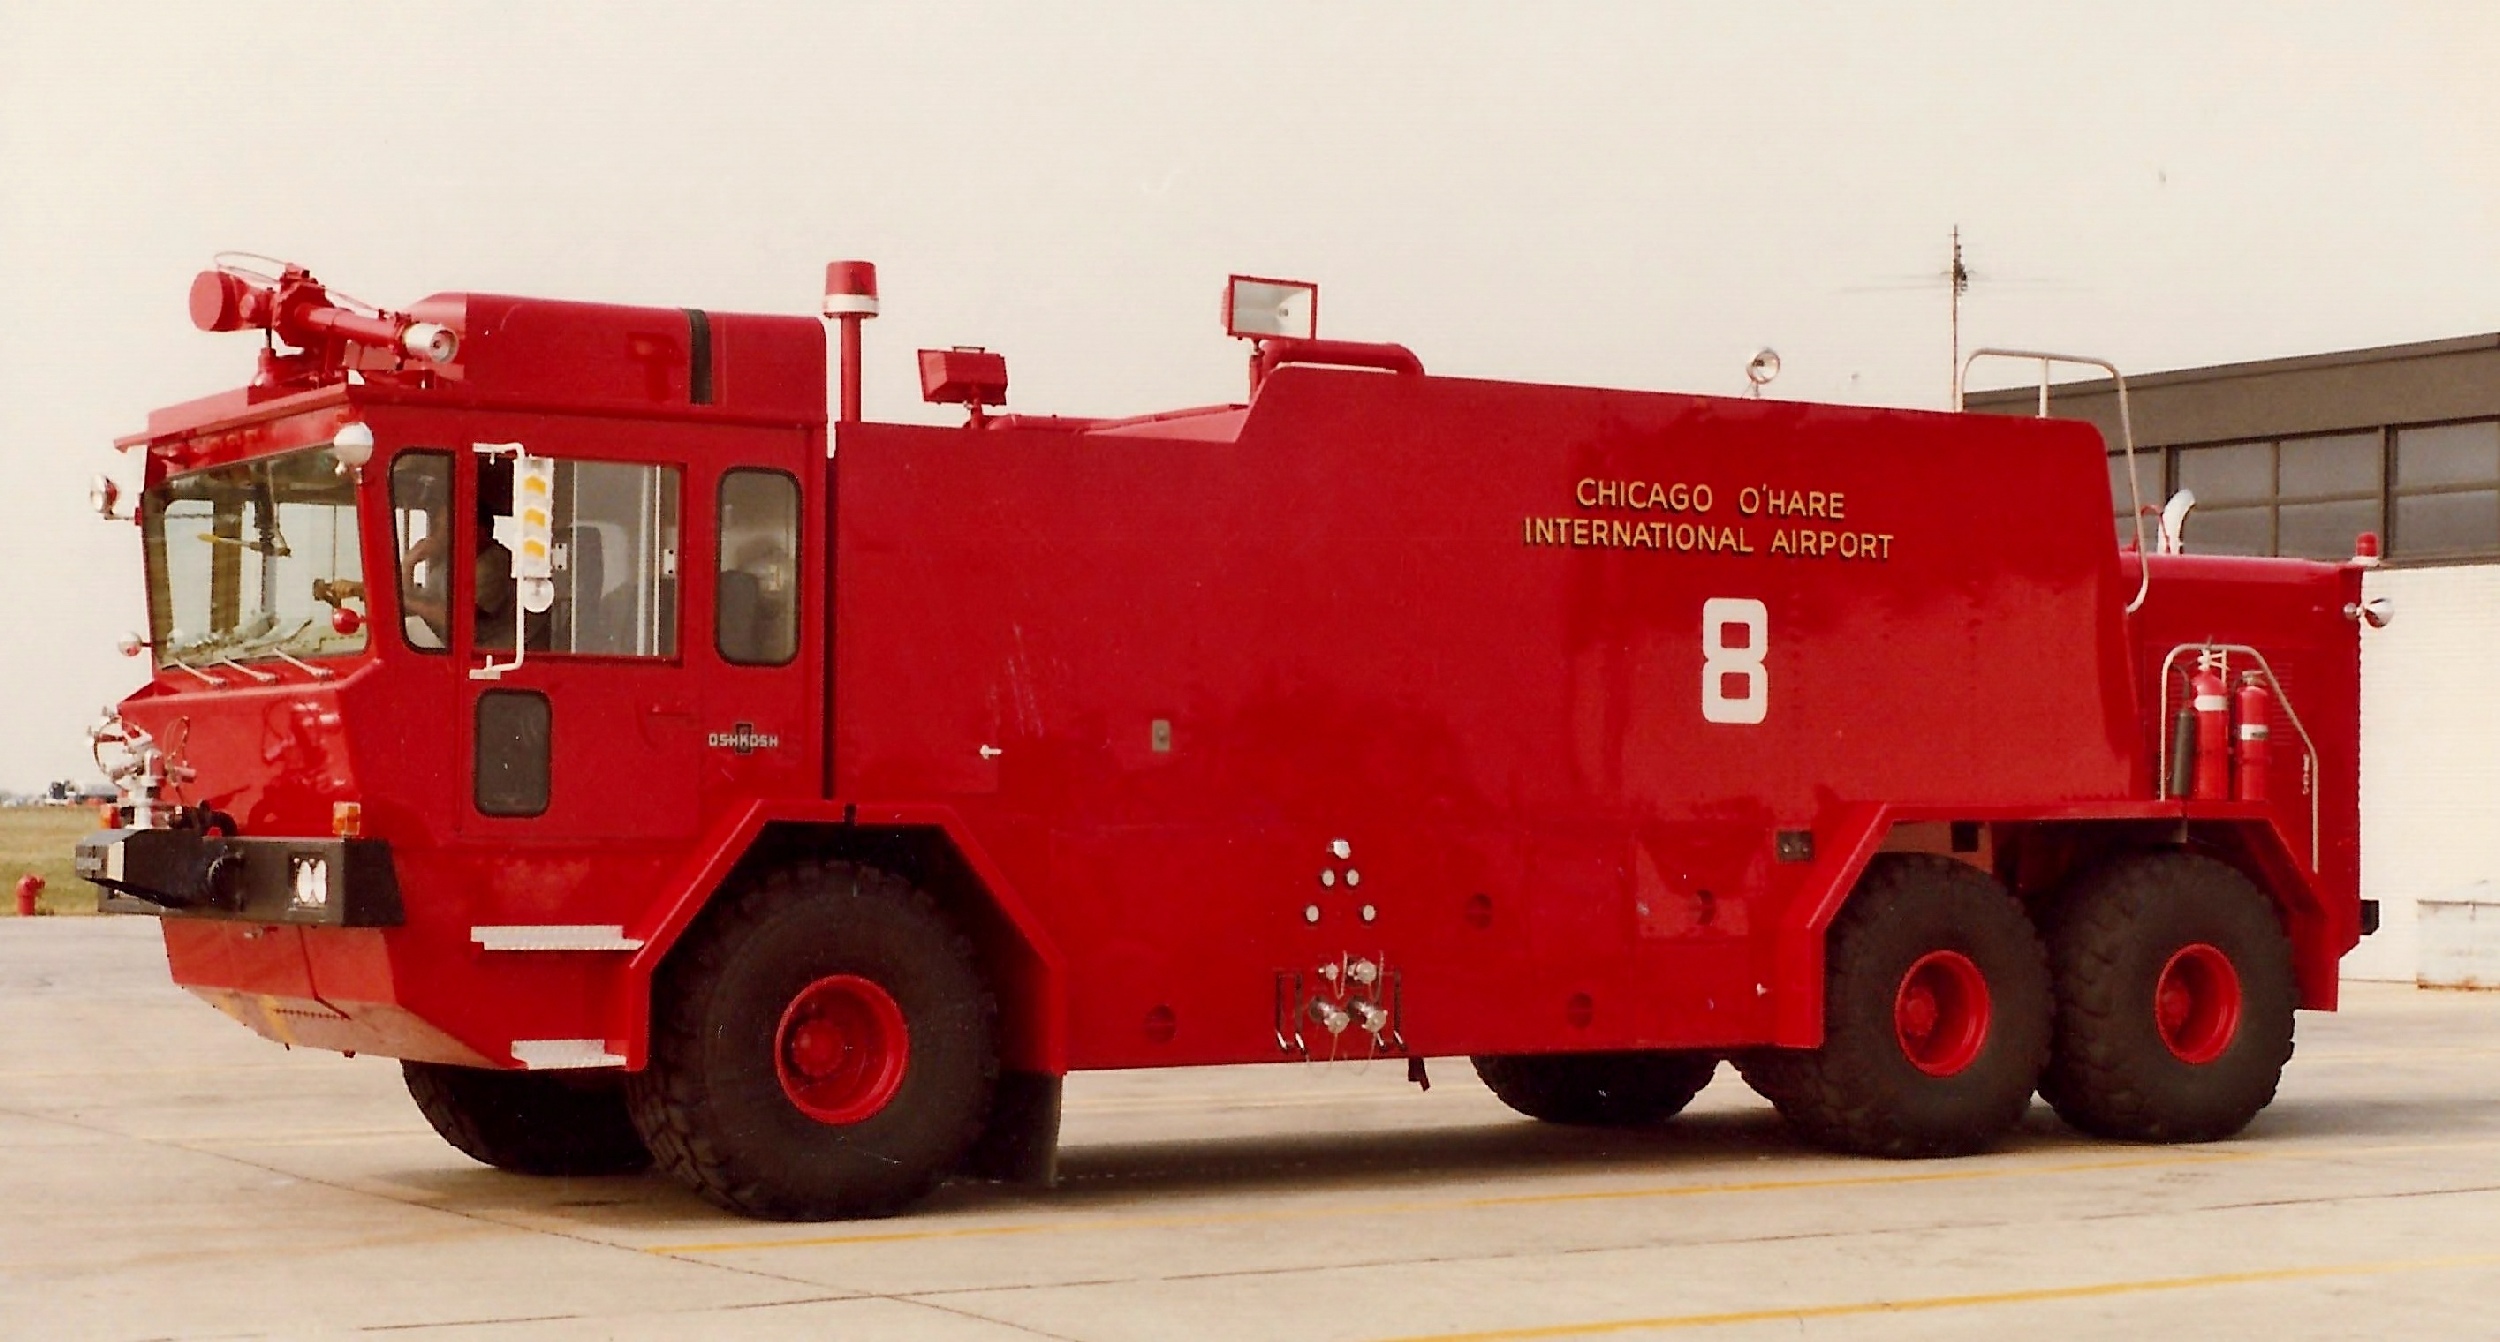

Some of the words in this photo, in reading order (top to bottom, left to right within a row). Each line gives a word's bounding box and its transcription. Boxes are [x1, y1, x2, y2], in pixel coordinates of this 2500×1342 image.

[1576, 477, 1713, 513] CHICAGO
[1739, 483, 1846, 519] O'HARE
[1524, 516, 1754, 554] INTERNATIONAL
[1770, 528, 1894, 560] AIRPORT
[1702, 597, 1769, 725] 8
[708, 733, 778, 748] OSHKOSH
